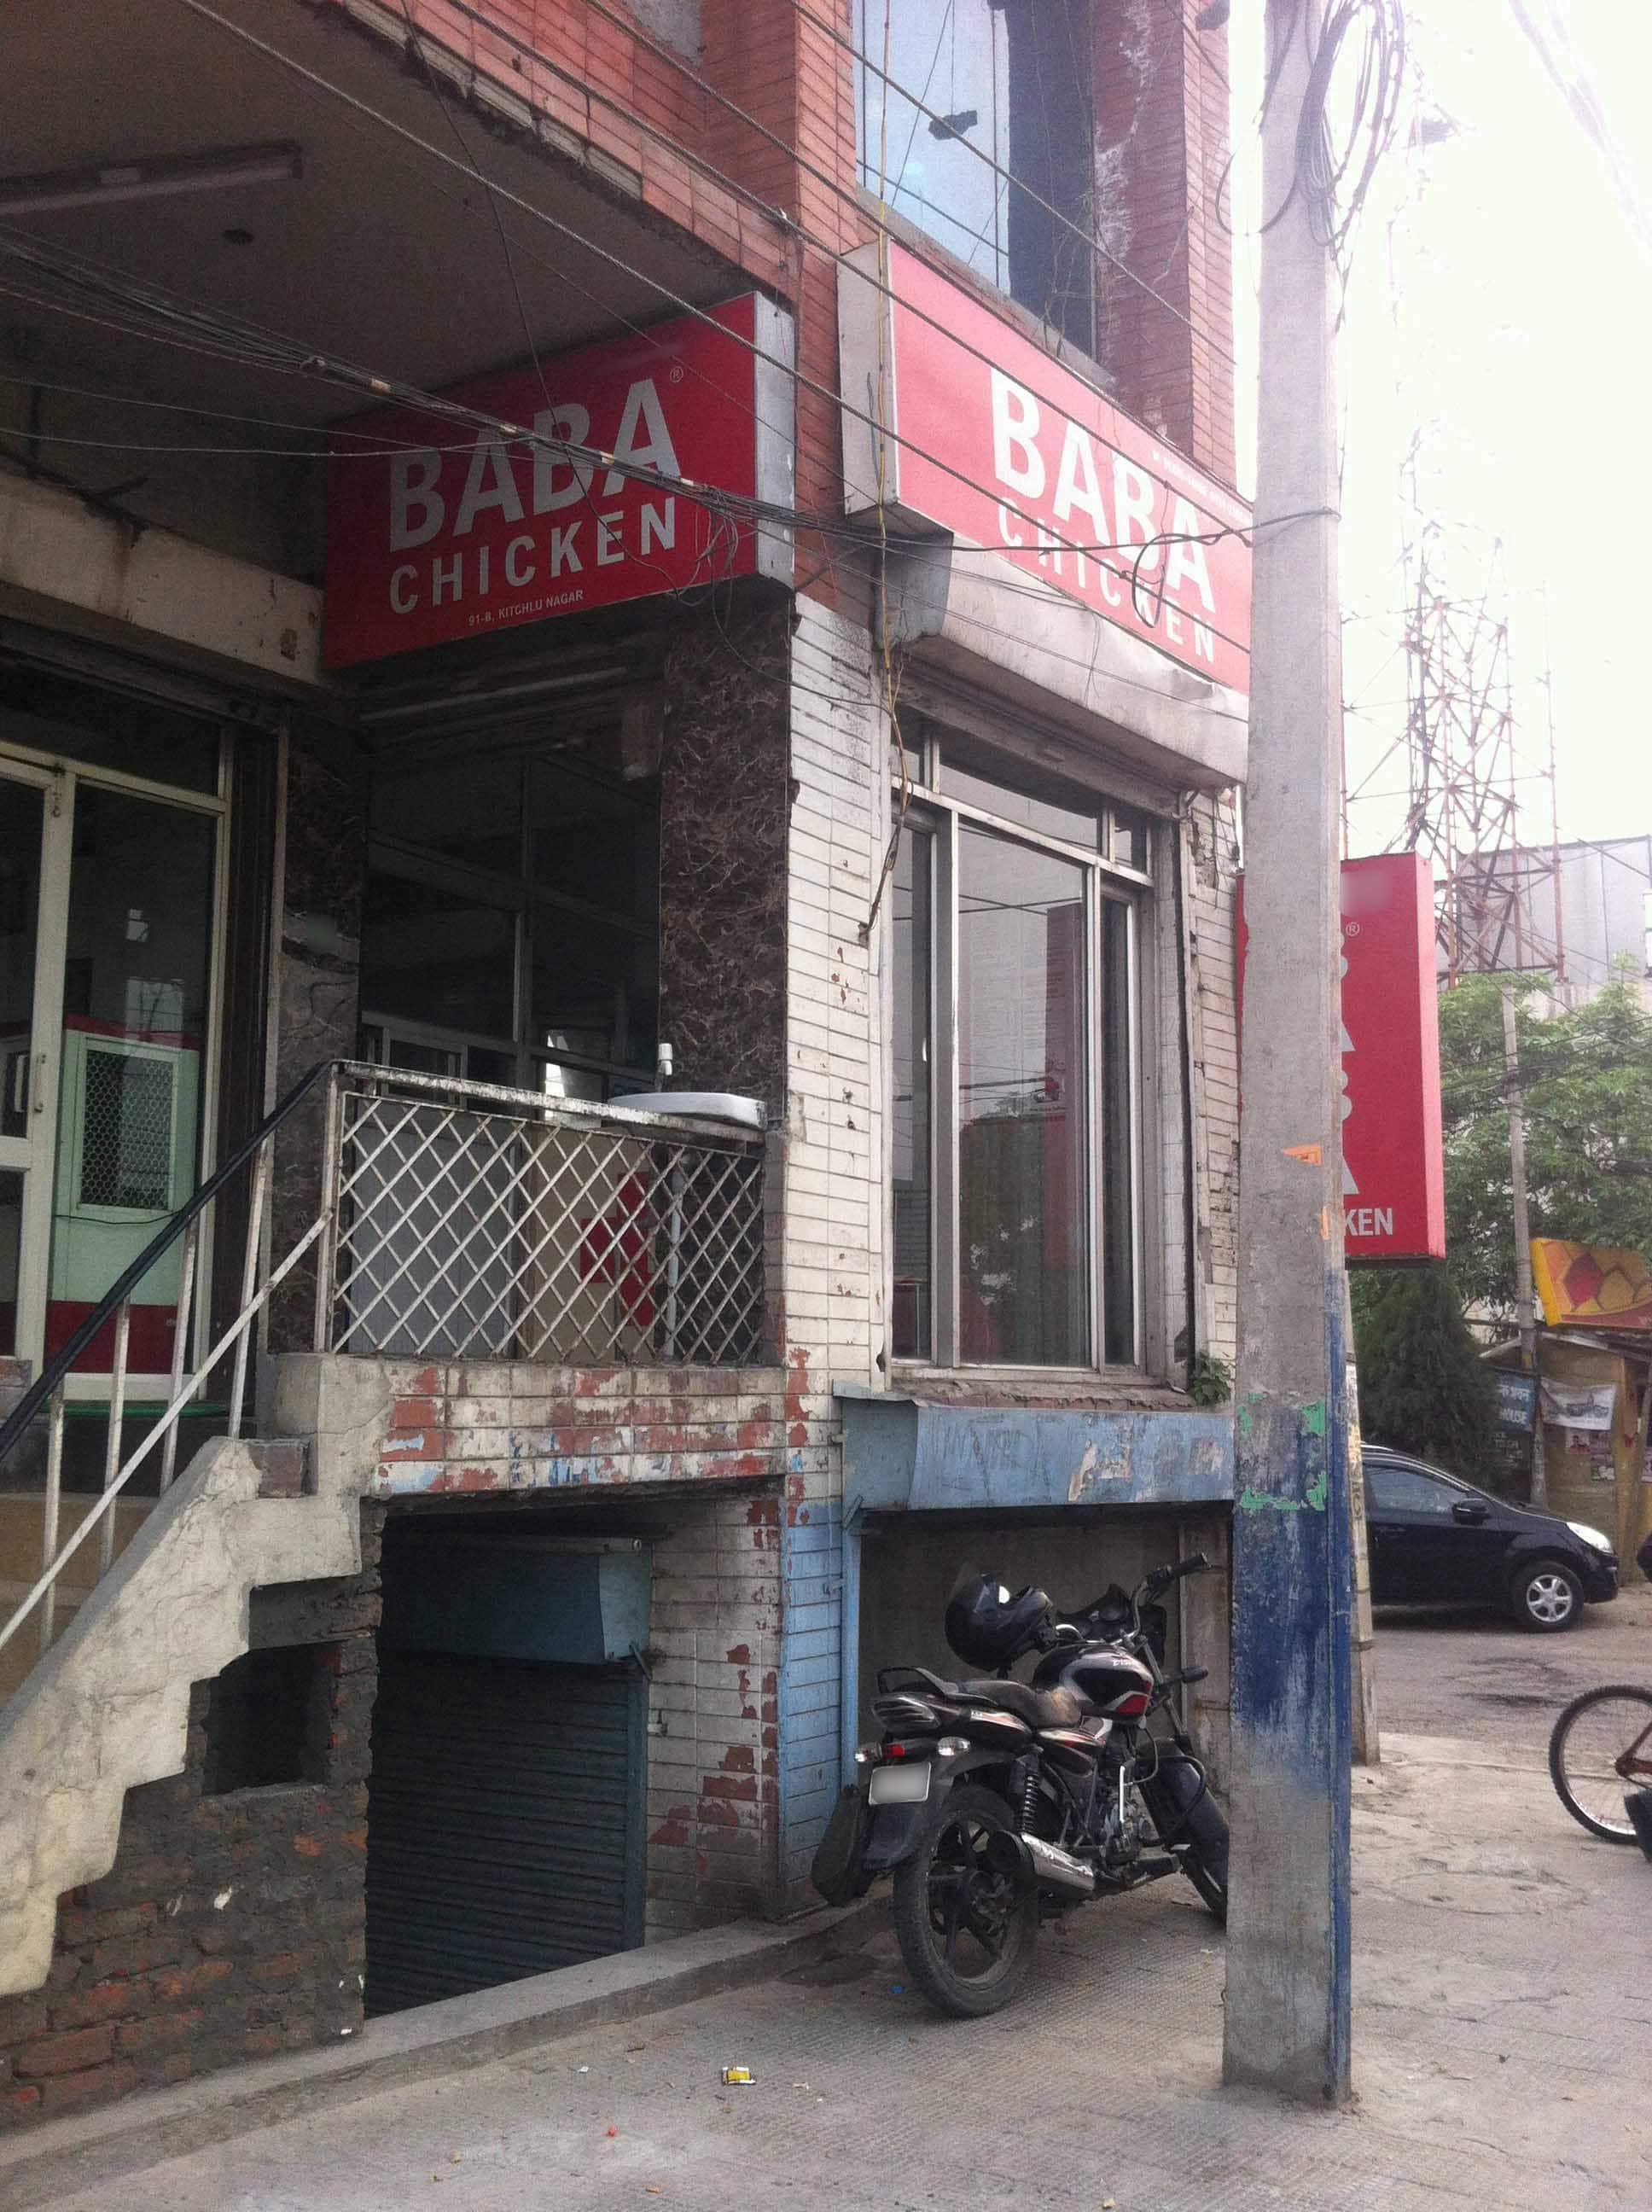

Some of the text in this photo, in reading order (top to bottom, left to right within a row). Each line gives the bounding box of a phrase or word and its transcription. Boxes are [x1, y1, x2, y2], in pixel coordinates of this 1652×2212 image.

[390, 378, 681, 553] BABA
[991, 368, 1217, 613] BABA
[390, 497, 676, 614] CHICKEN
[498, 599, 543, 620] KITCHLU
[546, 590, 584, 608] NAGAR
[998, 498, 1215, 664] CHICKEN
